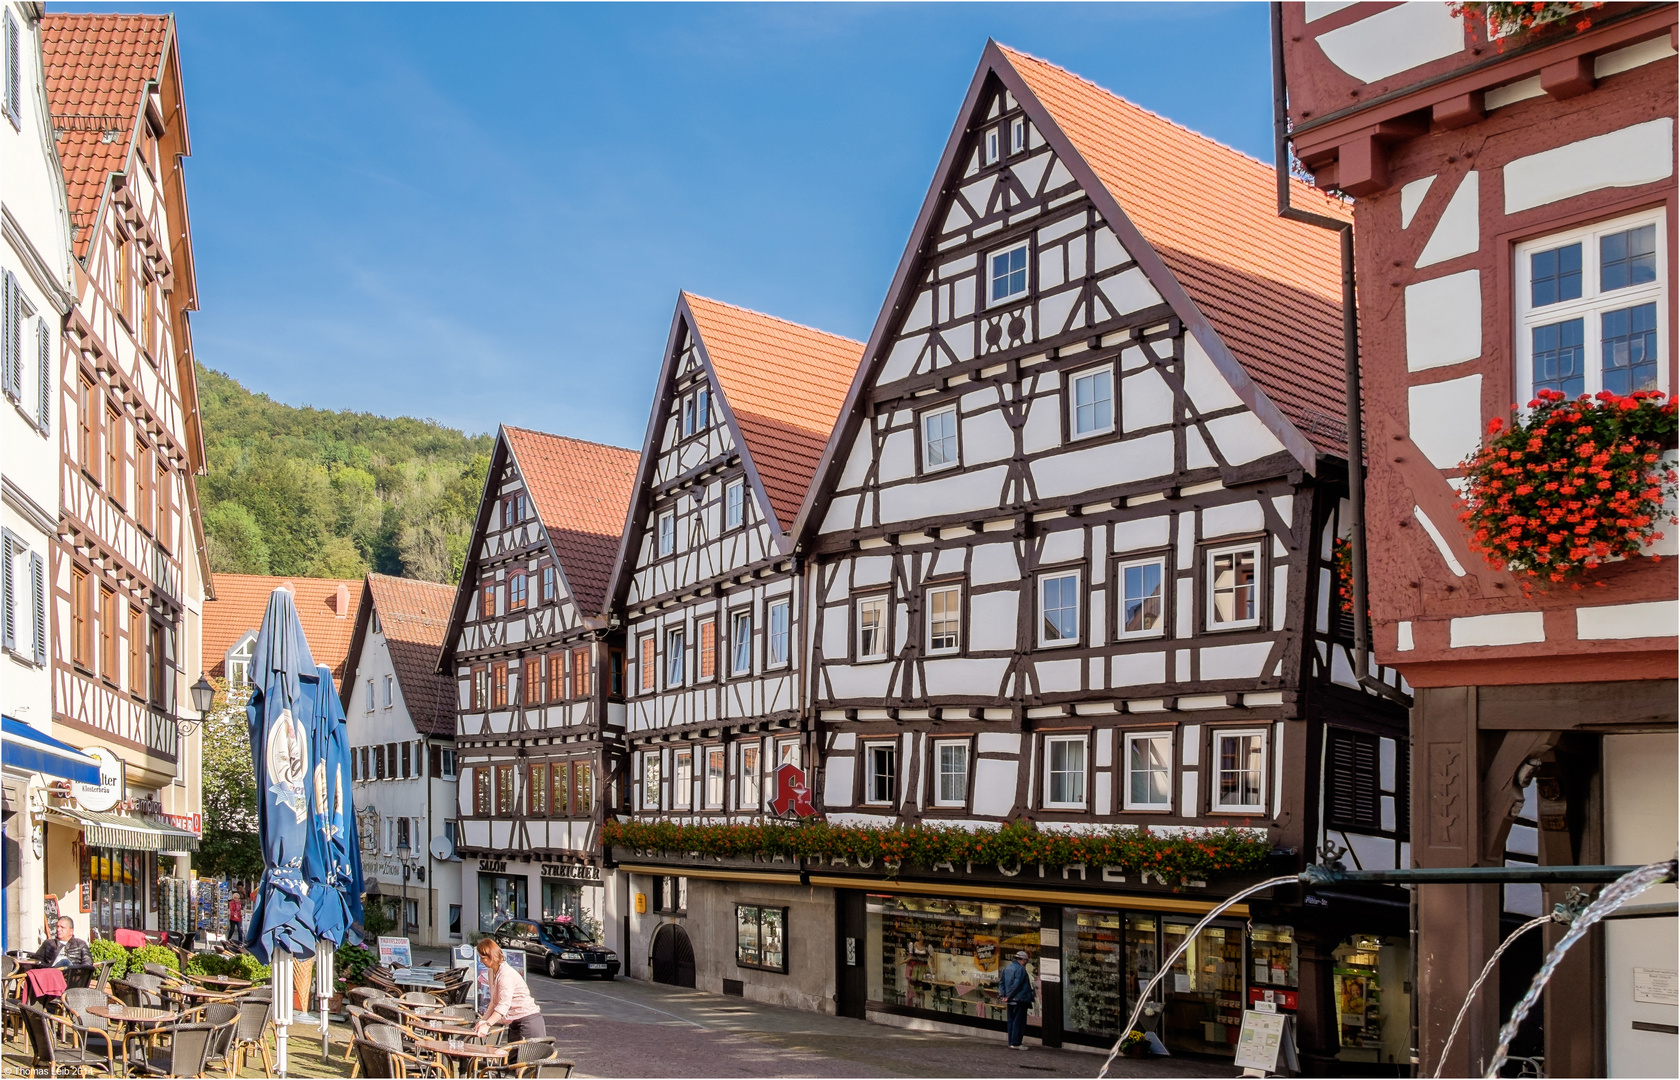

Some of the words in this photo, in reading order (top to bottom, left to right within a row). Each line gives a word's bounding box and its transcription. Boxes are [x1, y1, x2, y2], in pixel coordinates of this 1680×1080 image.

[81, 785, 110, 794] Klosterbräu
[479, 860, 507, 873] SALON
[541, 863, 600, 880] STREICHER
